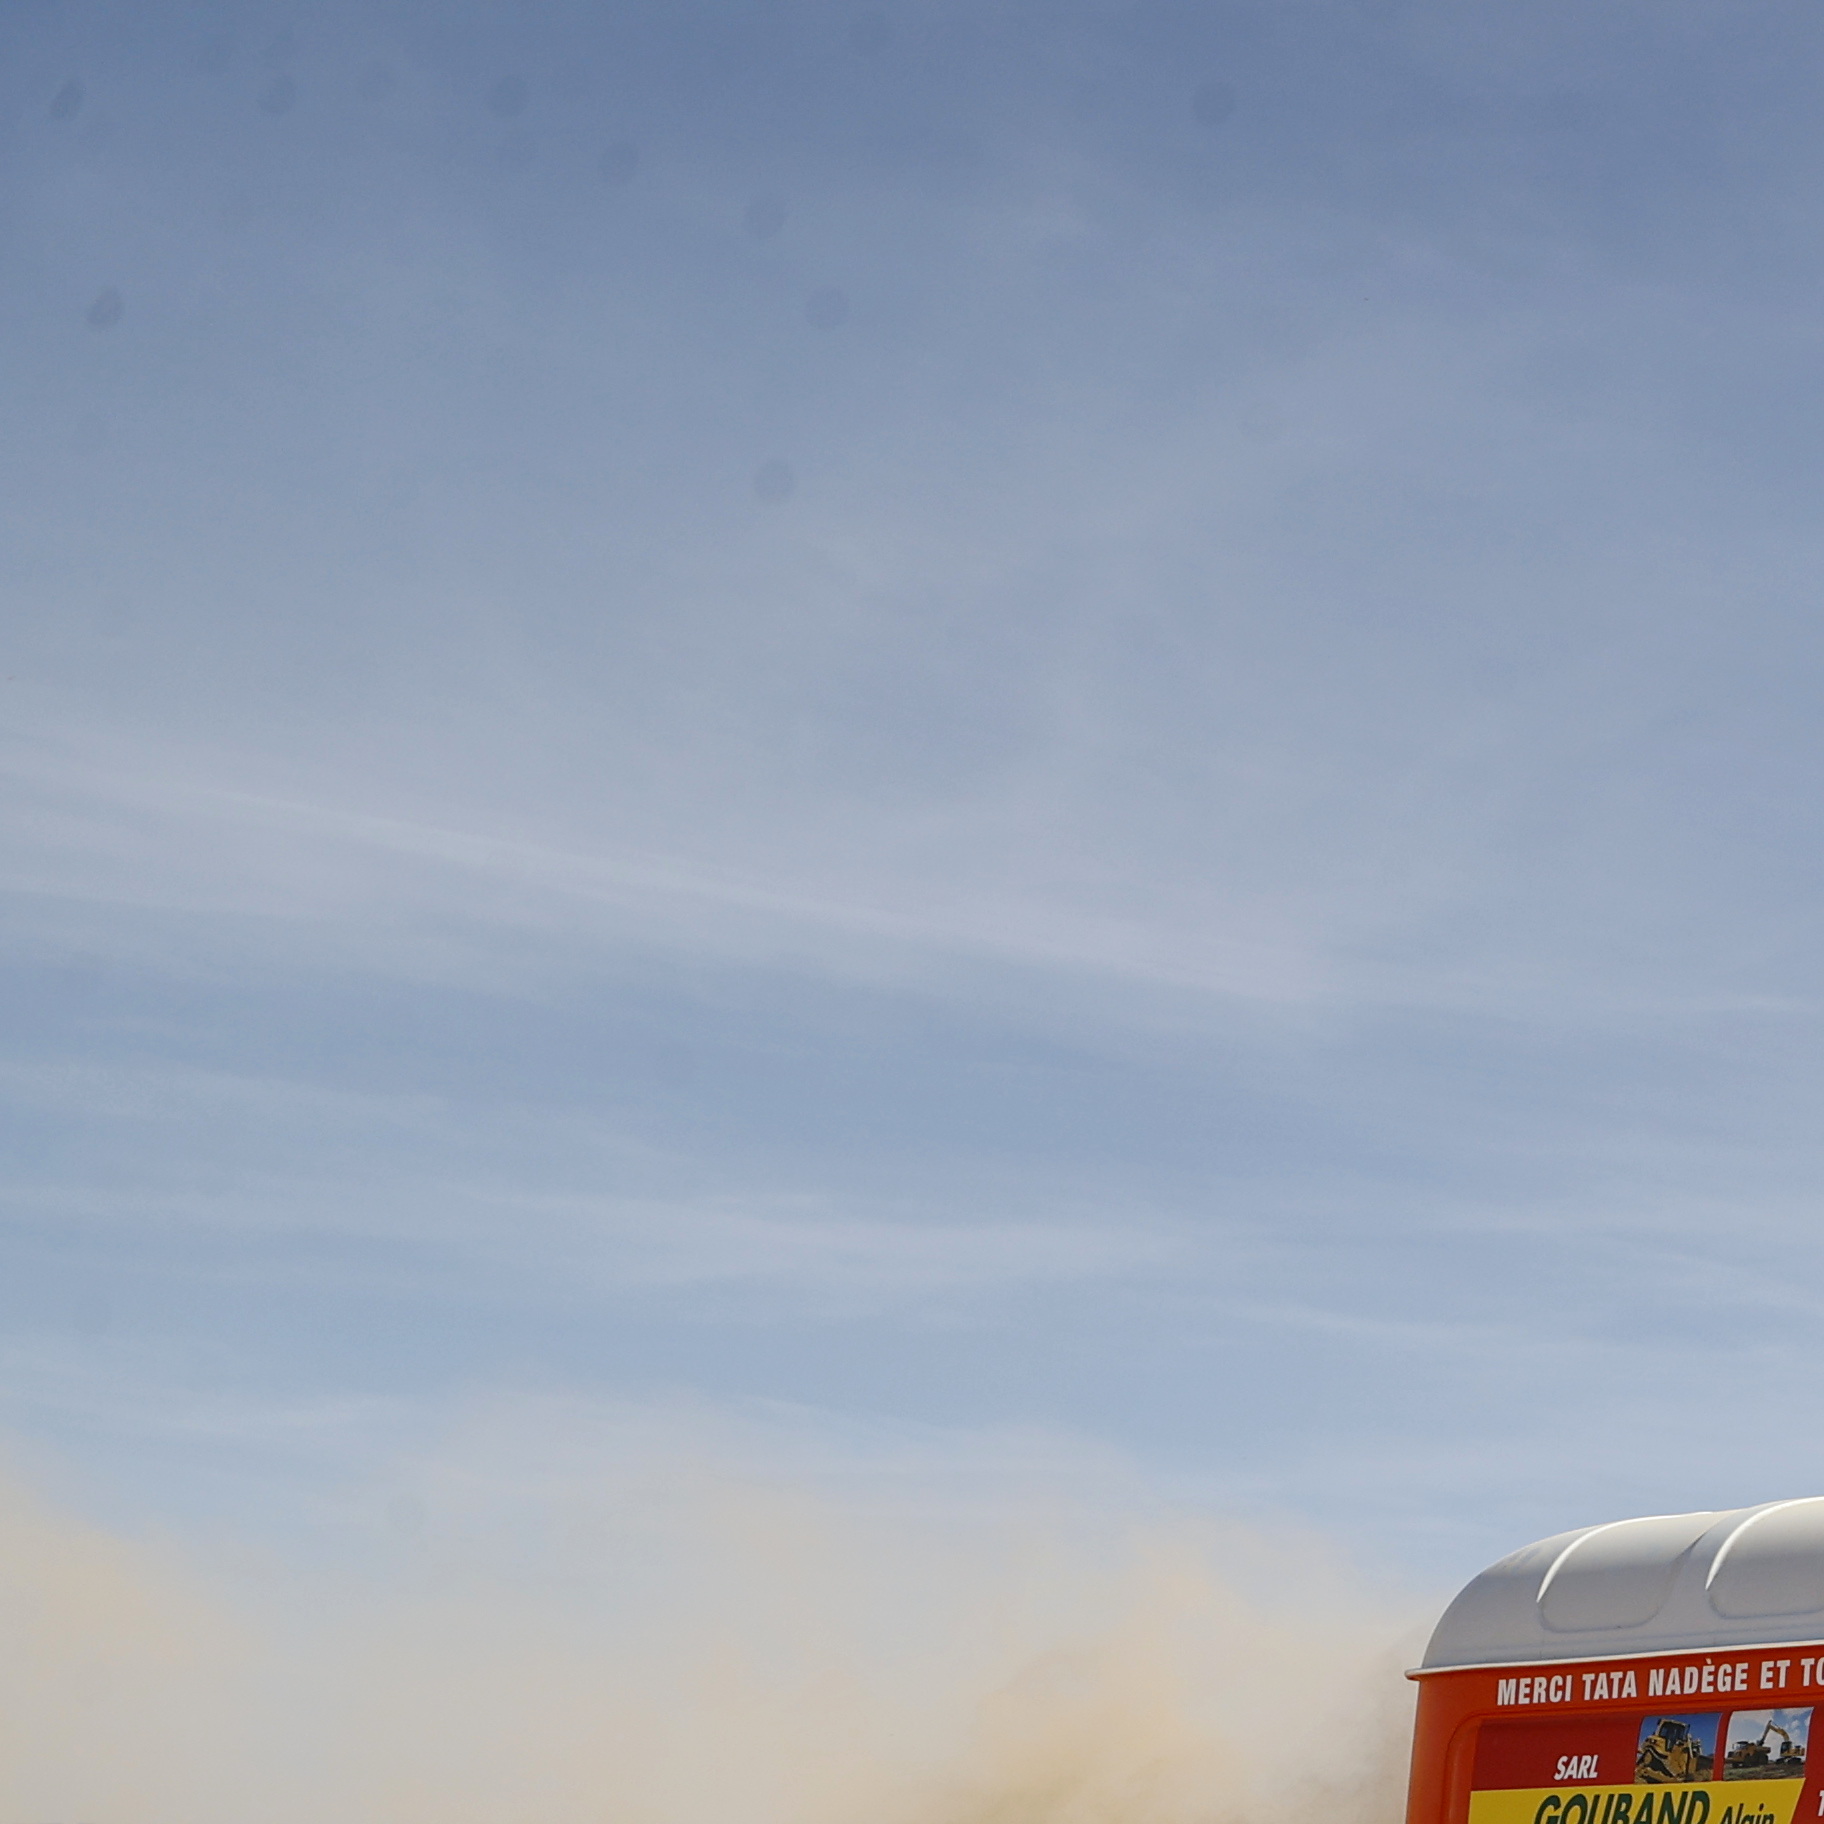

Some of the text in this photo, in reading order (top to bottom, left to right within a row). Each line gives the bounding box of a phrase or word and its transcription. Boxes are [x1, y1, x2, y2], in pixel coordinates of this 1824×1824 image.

[1497, 1675, 1572, 1706] MERCI
[1582, 1670, 1638, 1700] TATA
[1648, 1658, 1748, 1697] NADÈGE
[1760, 1660, 1791, 1689] ET
[1553, 1755, 1599, 1782] SARL
